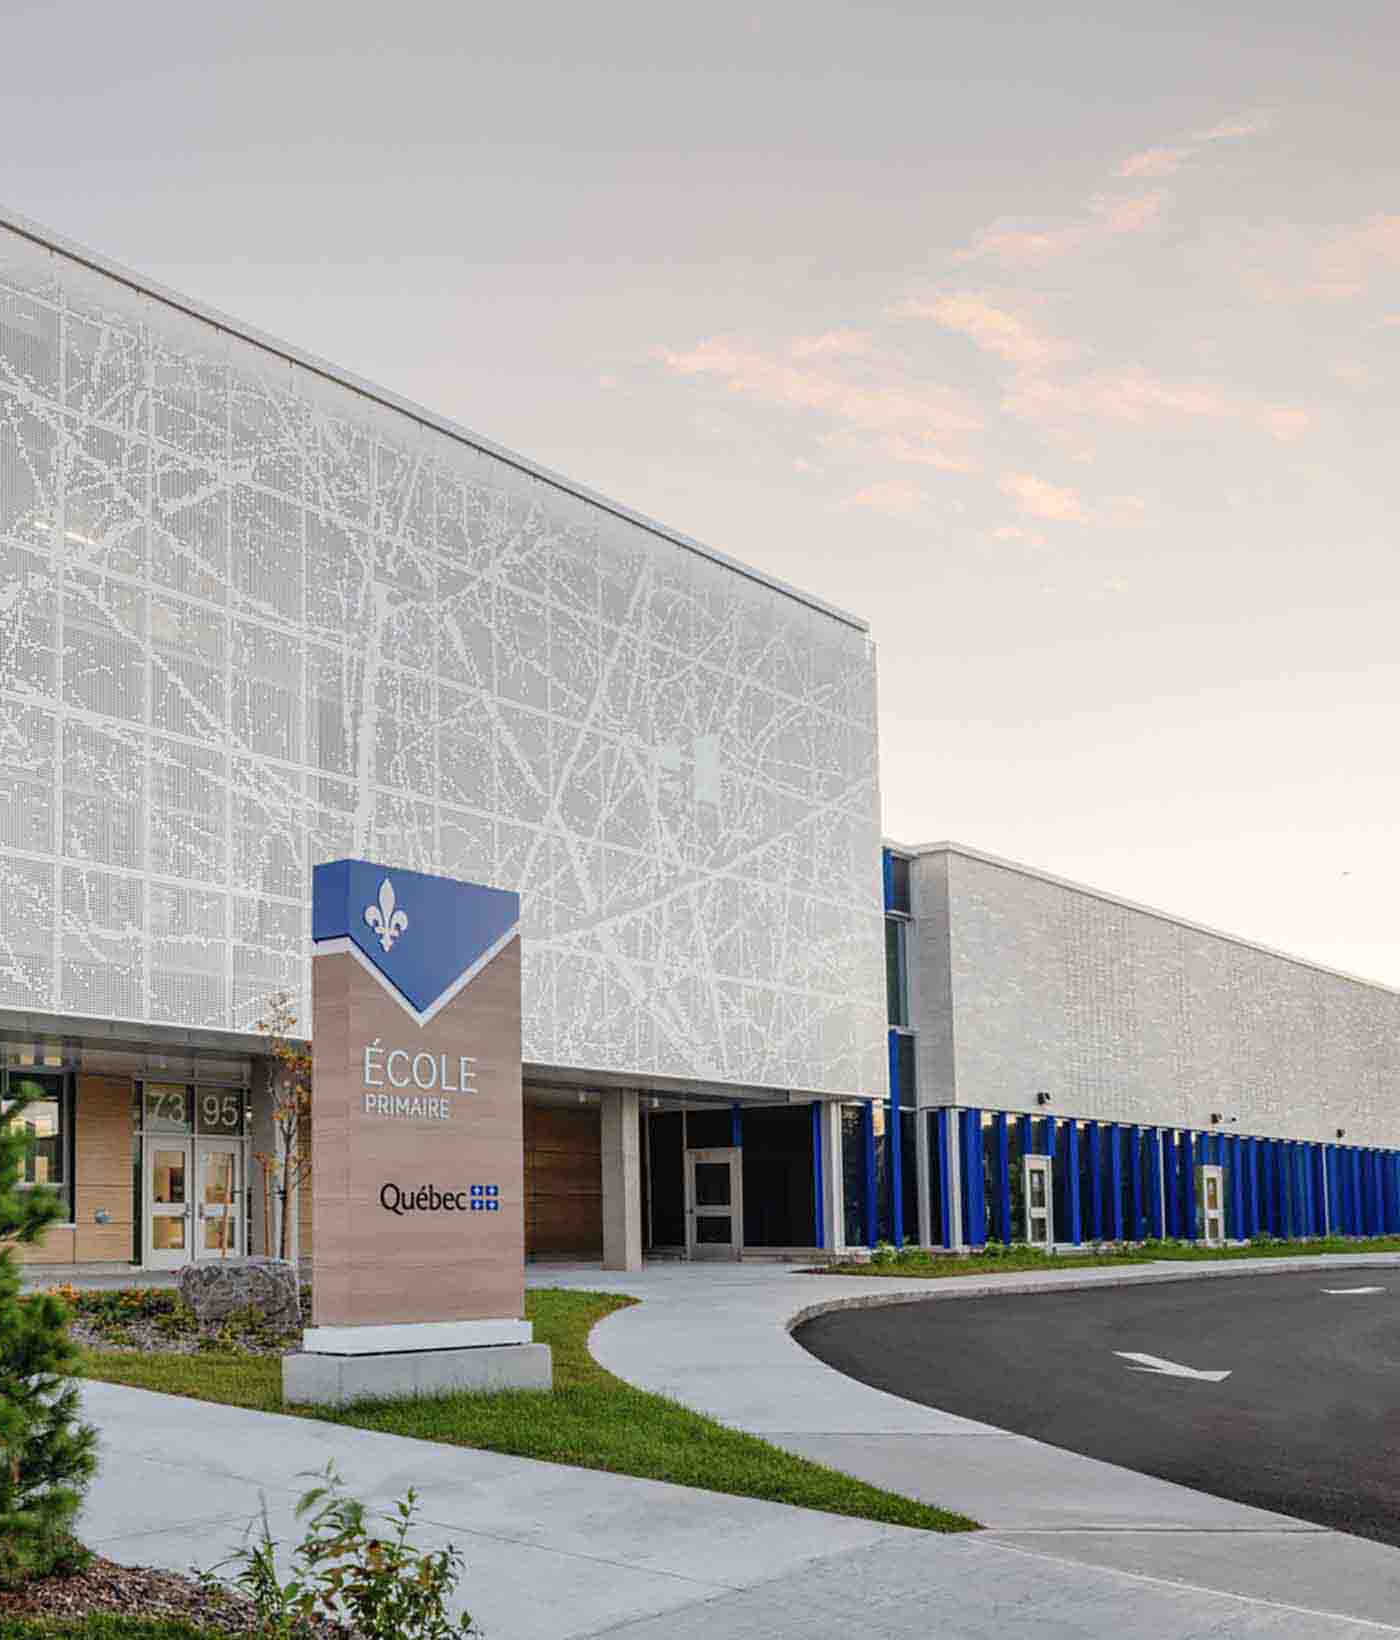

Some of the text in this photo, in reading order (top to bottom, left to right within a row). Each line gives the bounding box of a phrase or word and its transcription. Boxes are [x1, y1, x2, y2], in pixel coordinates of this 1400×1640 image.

[364, 1038, 478, 1094] ÉCOLE
[364, 1094, 450, 1120] PRIMAIRE
[380, 1183, 467, 1215] Québec
